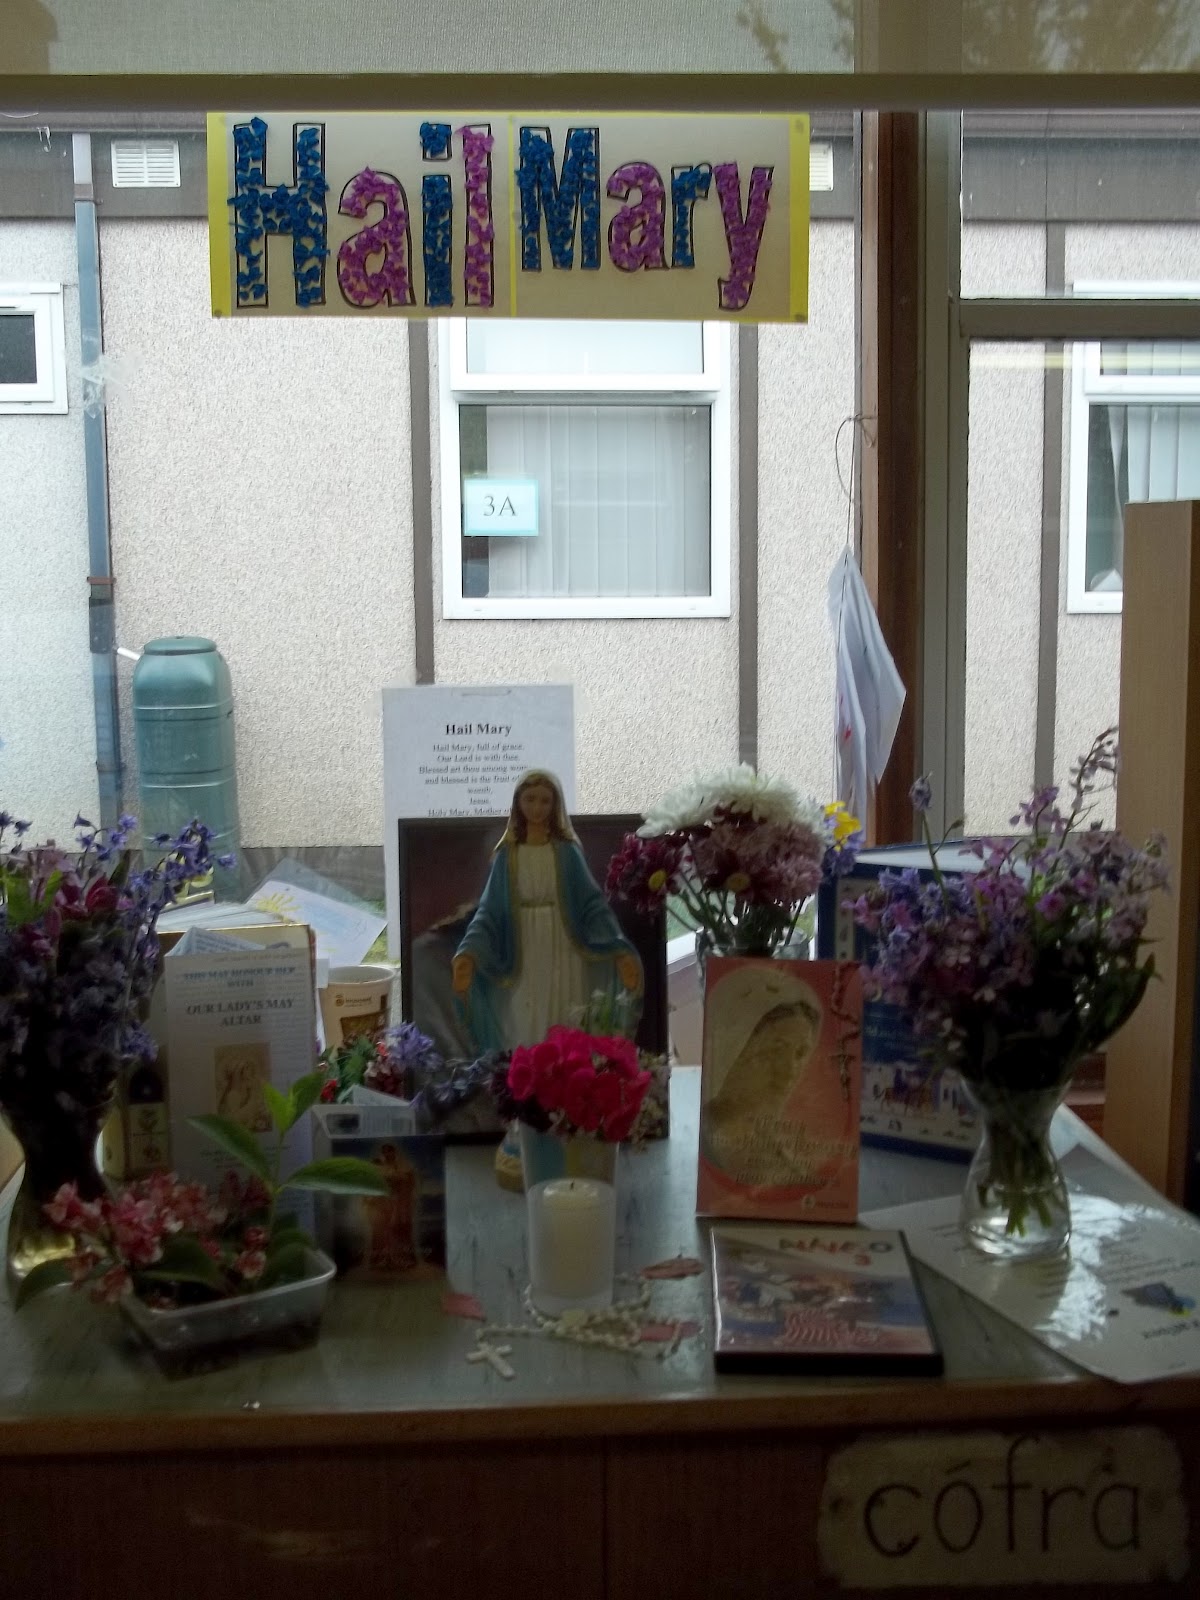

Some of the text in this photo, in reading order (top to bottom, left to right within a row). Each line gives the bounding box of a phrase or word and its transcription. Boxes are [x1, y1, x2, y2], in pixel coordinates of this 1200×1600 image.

[229, 117, 774, 311] Hail Mary
[483, 495, 517, 516] 3A
[445, 723, 512, 737] Hail Mary
[433, 744, 450, 753] Hail
[419, 766, 449, 775] Blessed
[187, 998, 294, 1016] OUR LADY'S MAY
[220, 1015, 261, 1027] ALTAR
